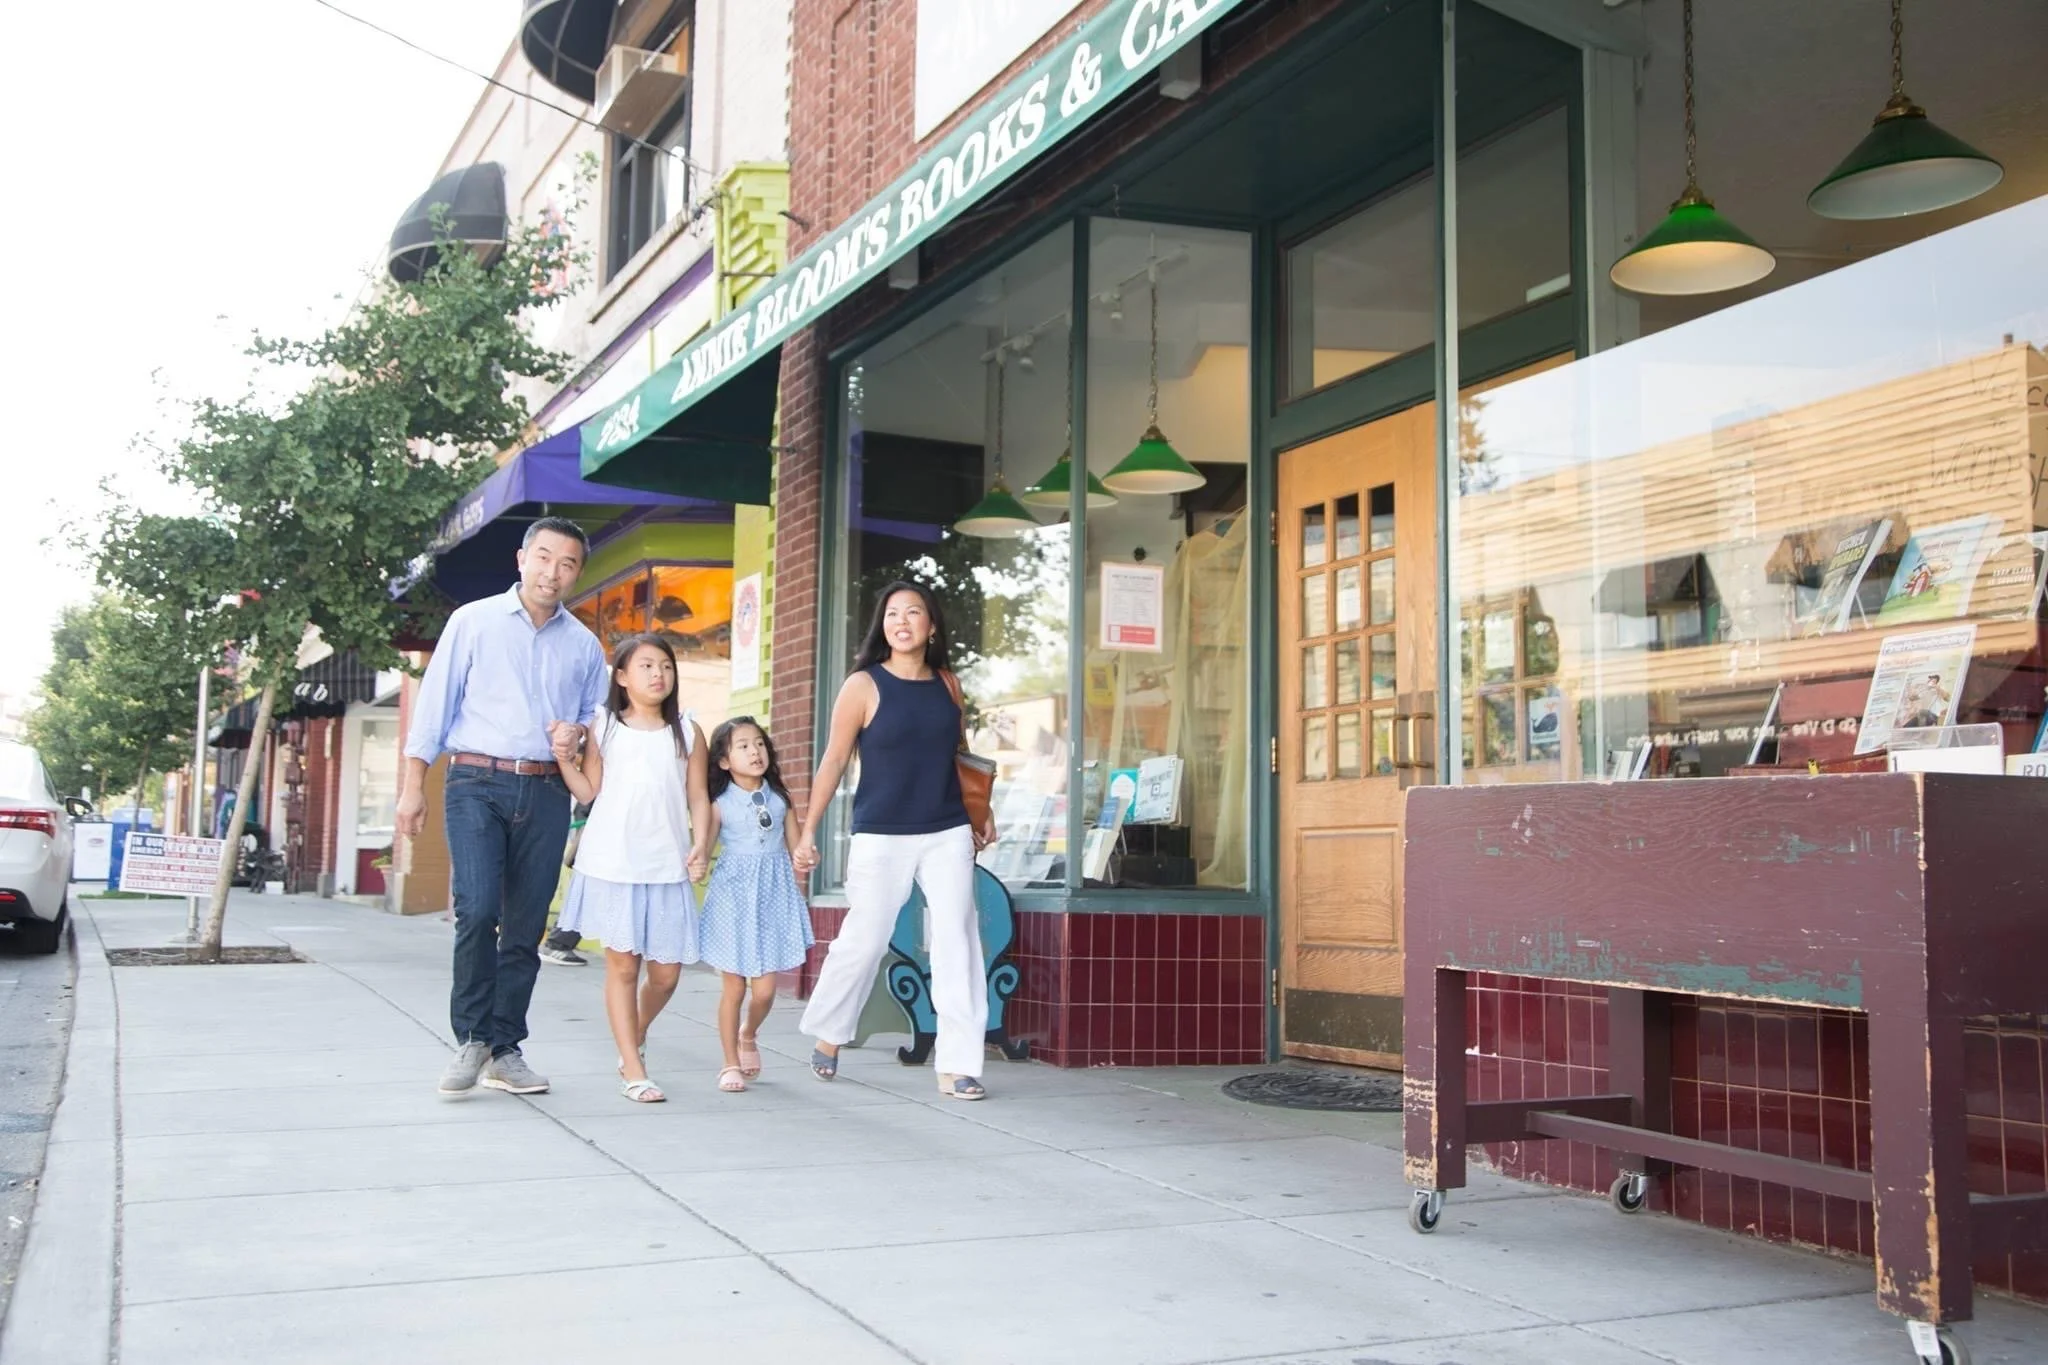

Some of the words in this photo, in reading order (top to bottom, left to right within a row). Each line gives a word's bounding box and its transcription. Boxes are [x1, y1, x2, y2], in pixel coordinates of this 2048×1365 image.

[671, 310, 751, 404] ANNIE
[753, 202, 891, 350] BLOOM'S
[895, 73, 1049, 245] BOOKS
[1060, 42, 1101, 118] &
[1119, 0, 1218, 69] CA
